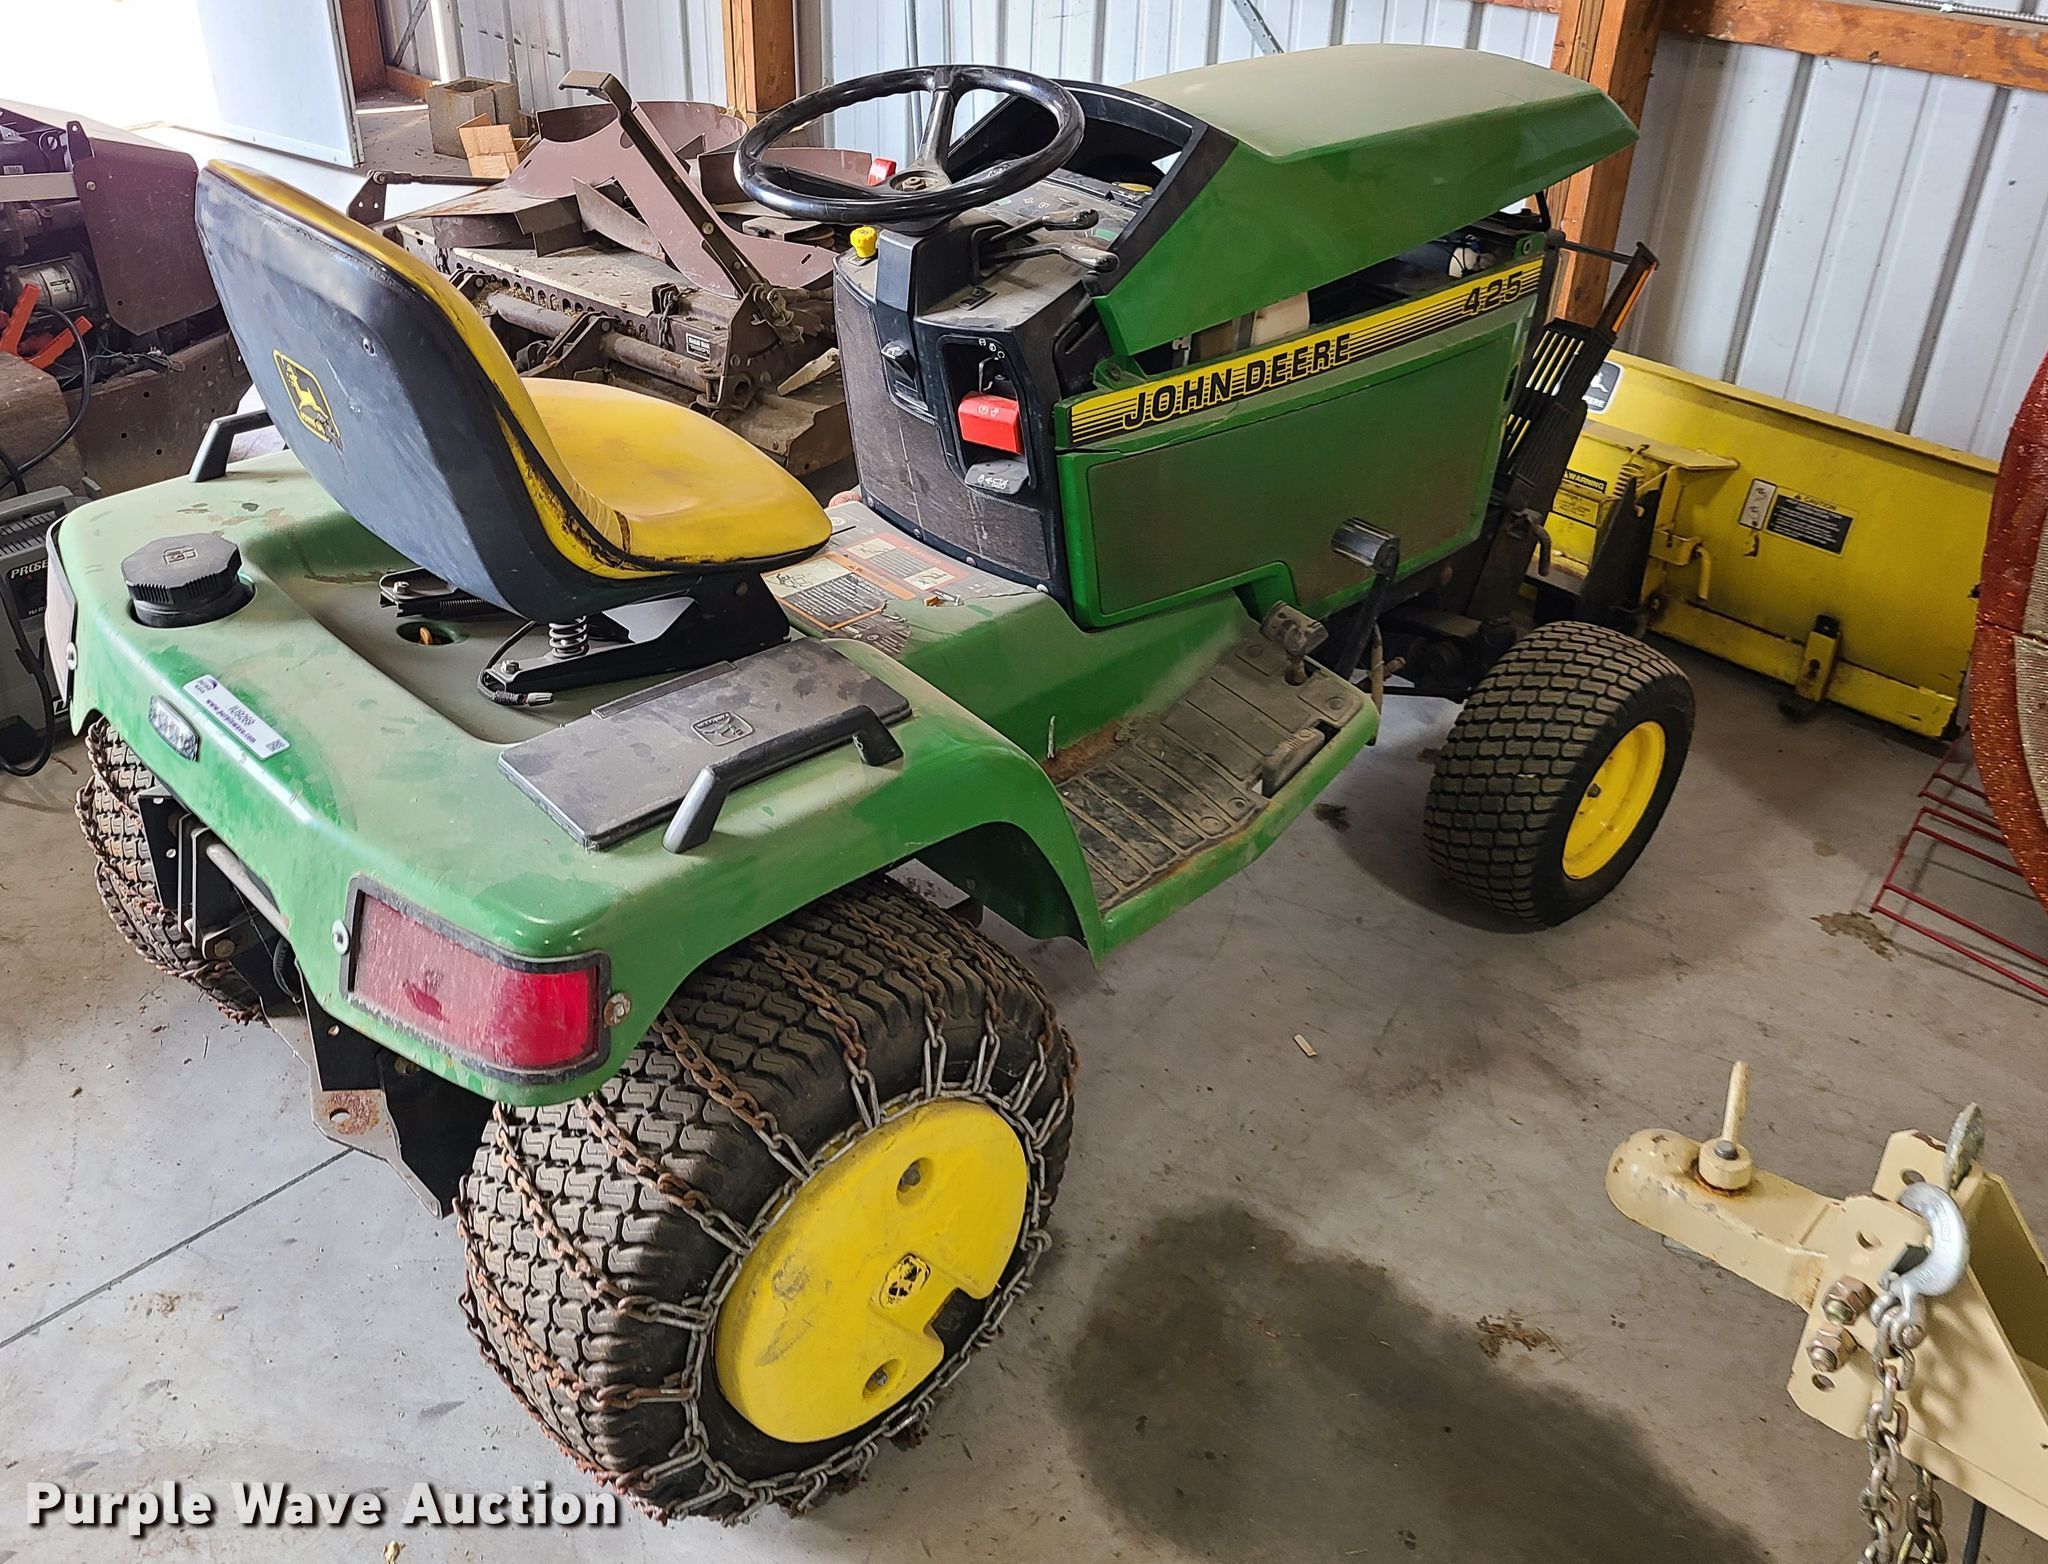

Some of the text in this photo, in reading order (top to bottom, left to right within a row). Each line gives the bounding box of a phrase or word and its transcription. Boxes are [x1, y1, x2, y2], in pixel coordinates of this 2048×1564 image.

[1122, 270, 1525, 430] JOHN DEERE 425
[1568, 472, 1606, 491] WARNING
